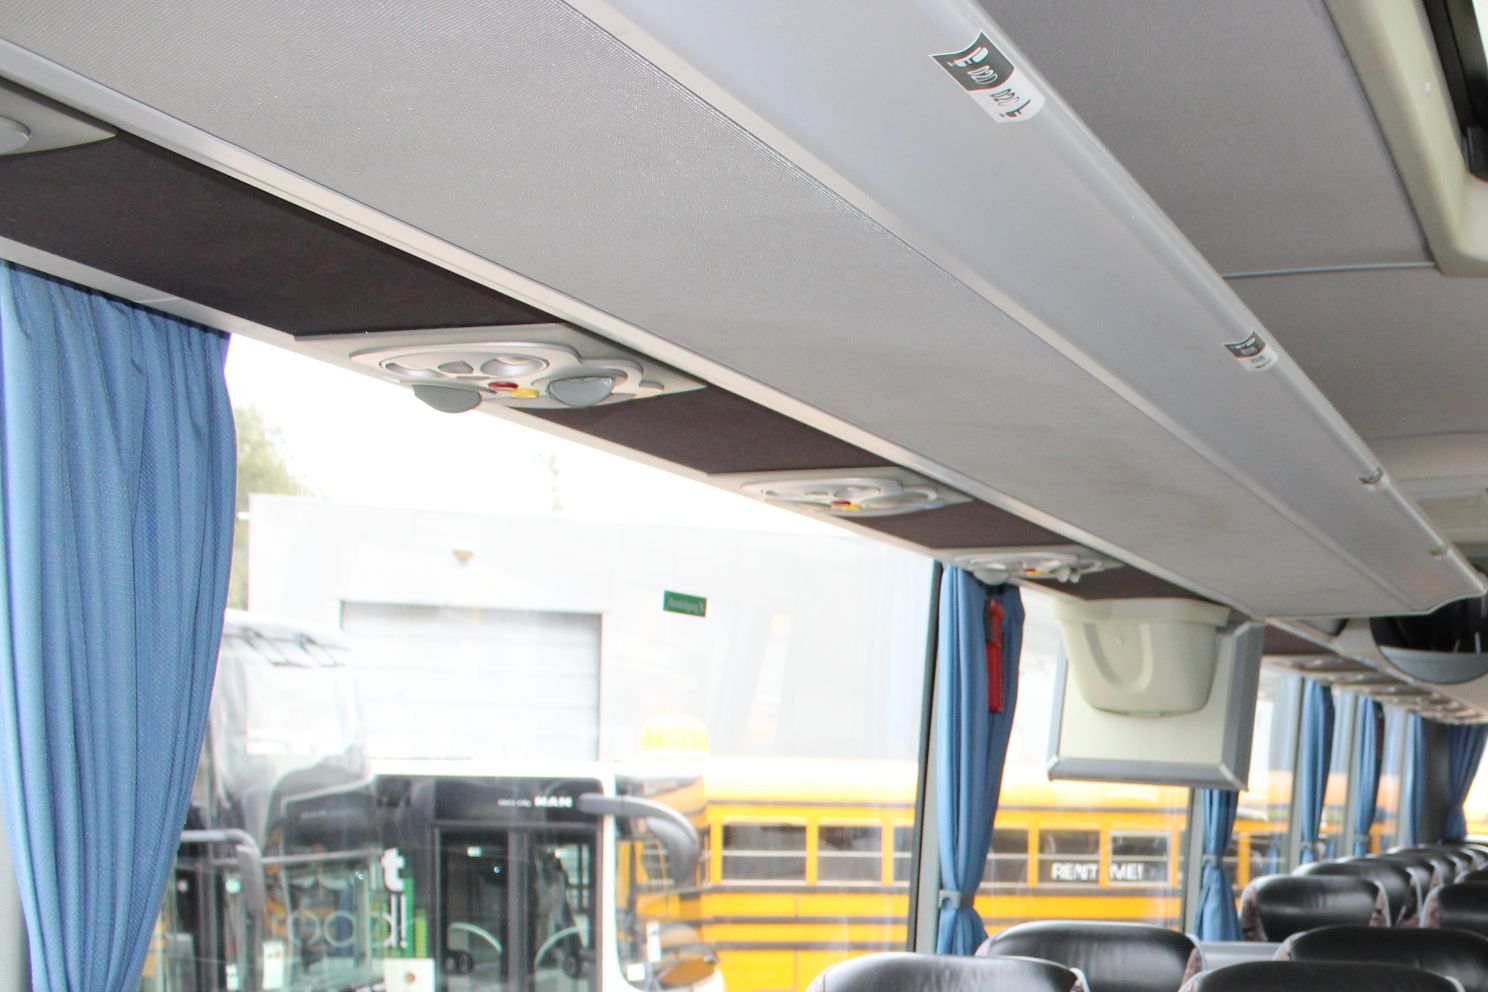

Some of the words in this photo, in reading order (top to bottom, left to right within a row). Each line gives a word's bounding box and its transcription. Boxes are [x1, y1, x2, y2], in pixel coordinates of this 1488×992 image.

[533, 796, 573, 808] MAN
[1051, 863, 1099, 881] RENT
[1110, 863, 1144, 881] ME!
